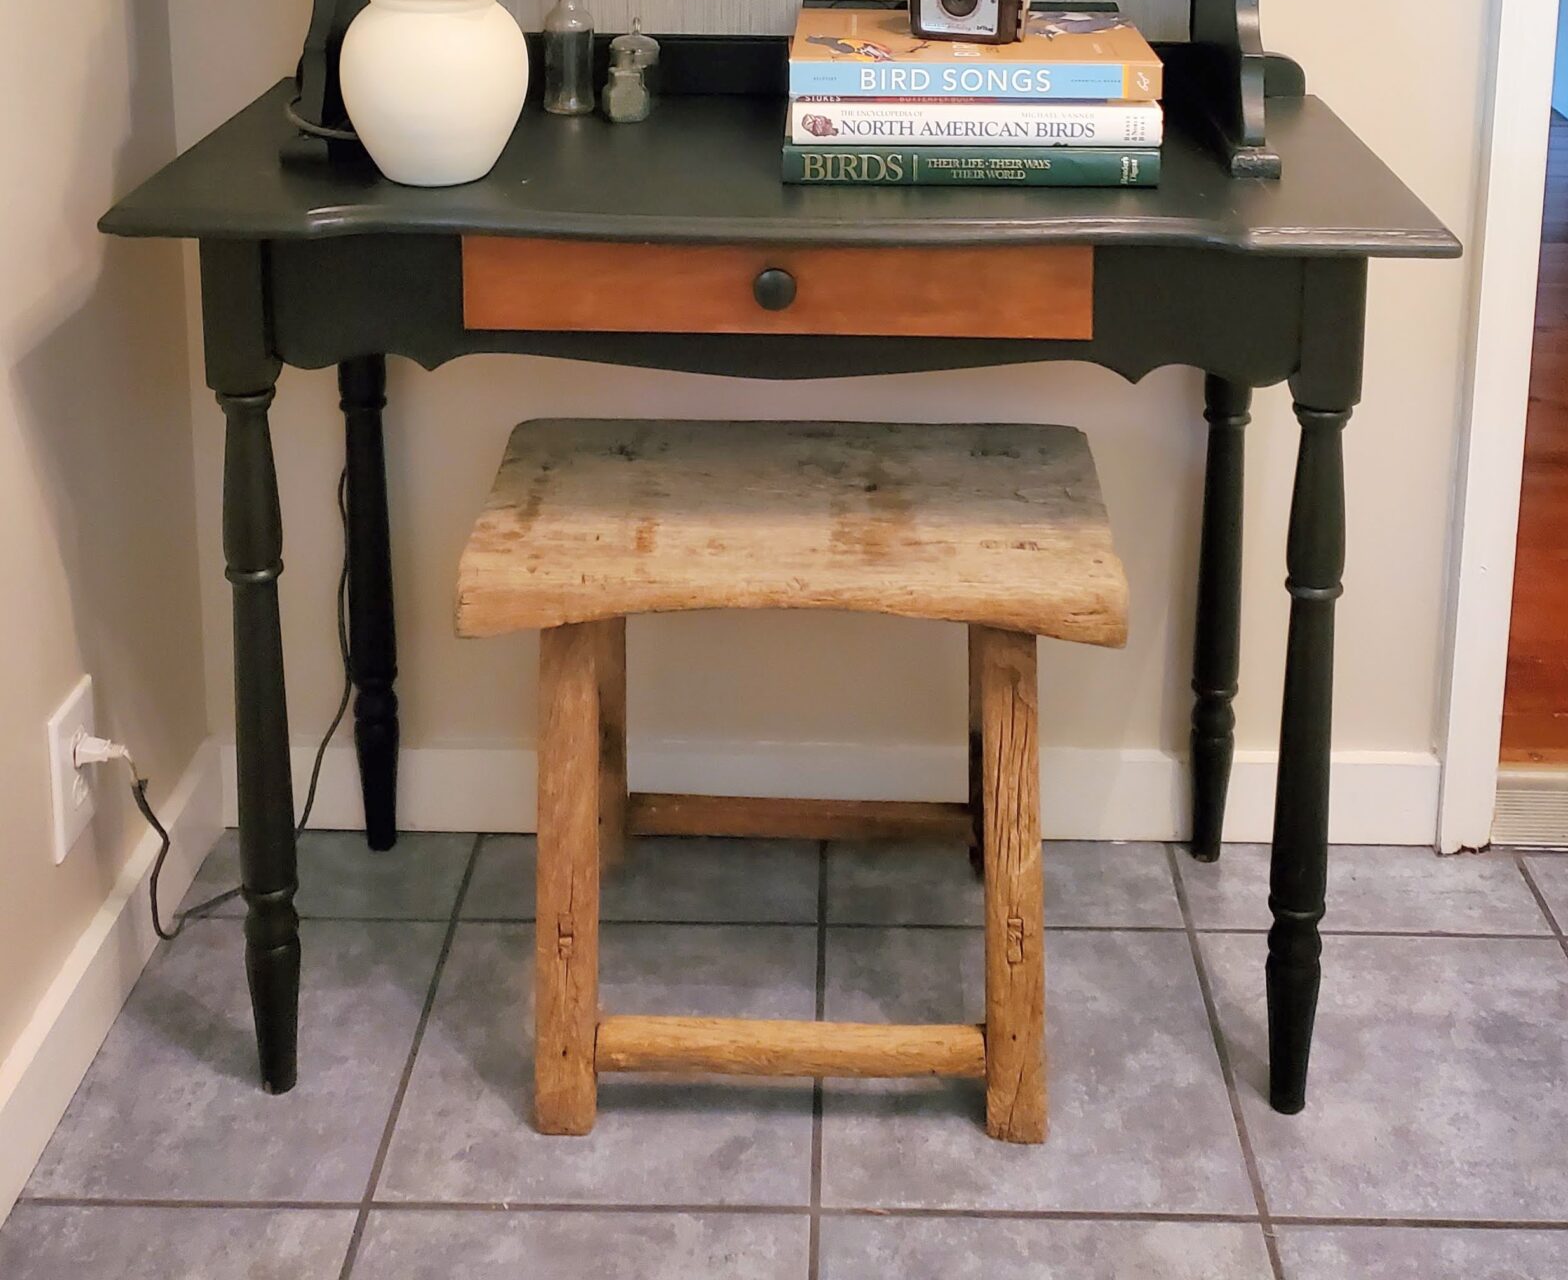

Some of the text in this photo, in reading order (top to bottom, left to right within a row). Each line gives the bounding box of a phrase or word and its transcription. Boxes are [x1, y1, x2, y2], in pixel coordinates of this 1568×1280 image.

[860, 68, 1052, 92] BIRD SONGS
[840, 110, 924, 118] THE ENCYCLOPEDIA OF
[1020, 111, 1059, 119] MICHAEL
[840, 120, 1096, 138] NORTH AMERICAN BIRDS
[801, 153, 904, 182] BIRDS
[926, 158, 1052, 169] THEIR LIFE THEIR WAYS
[951, 169, 1027, 180] THEIR WORLD
